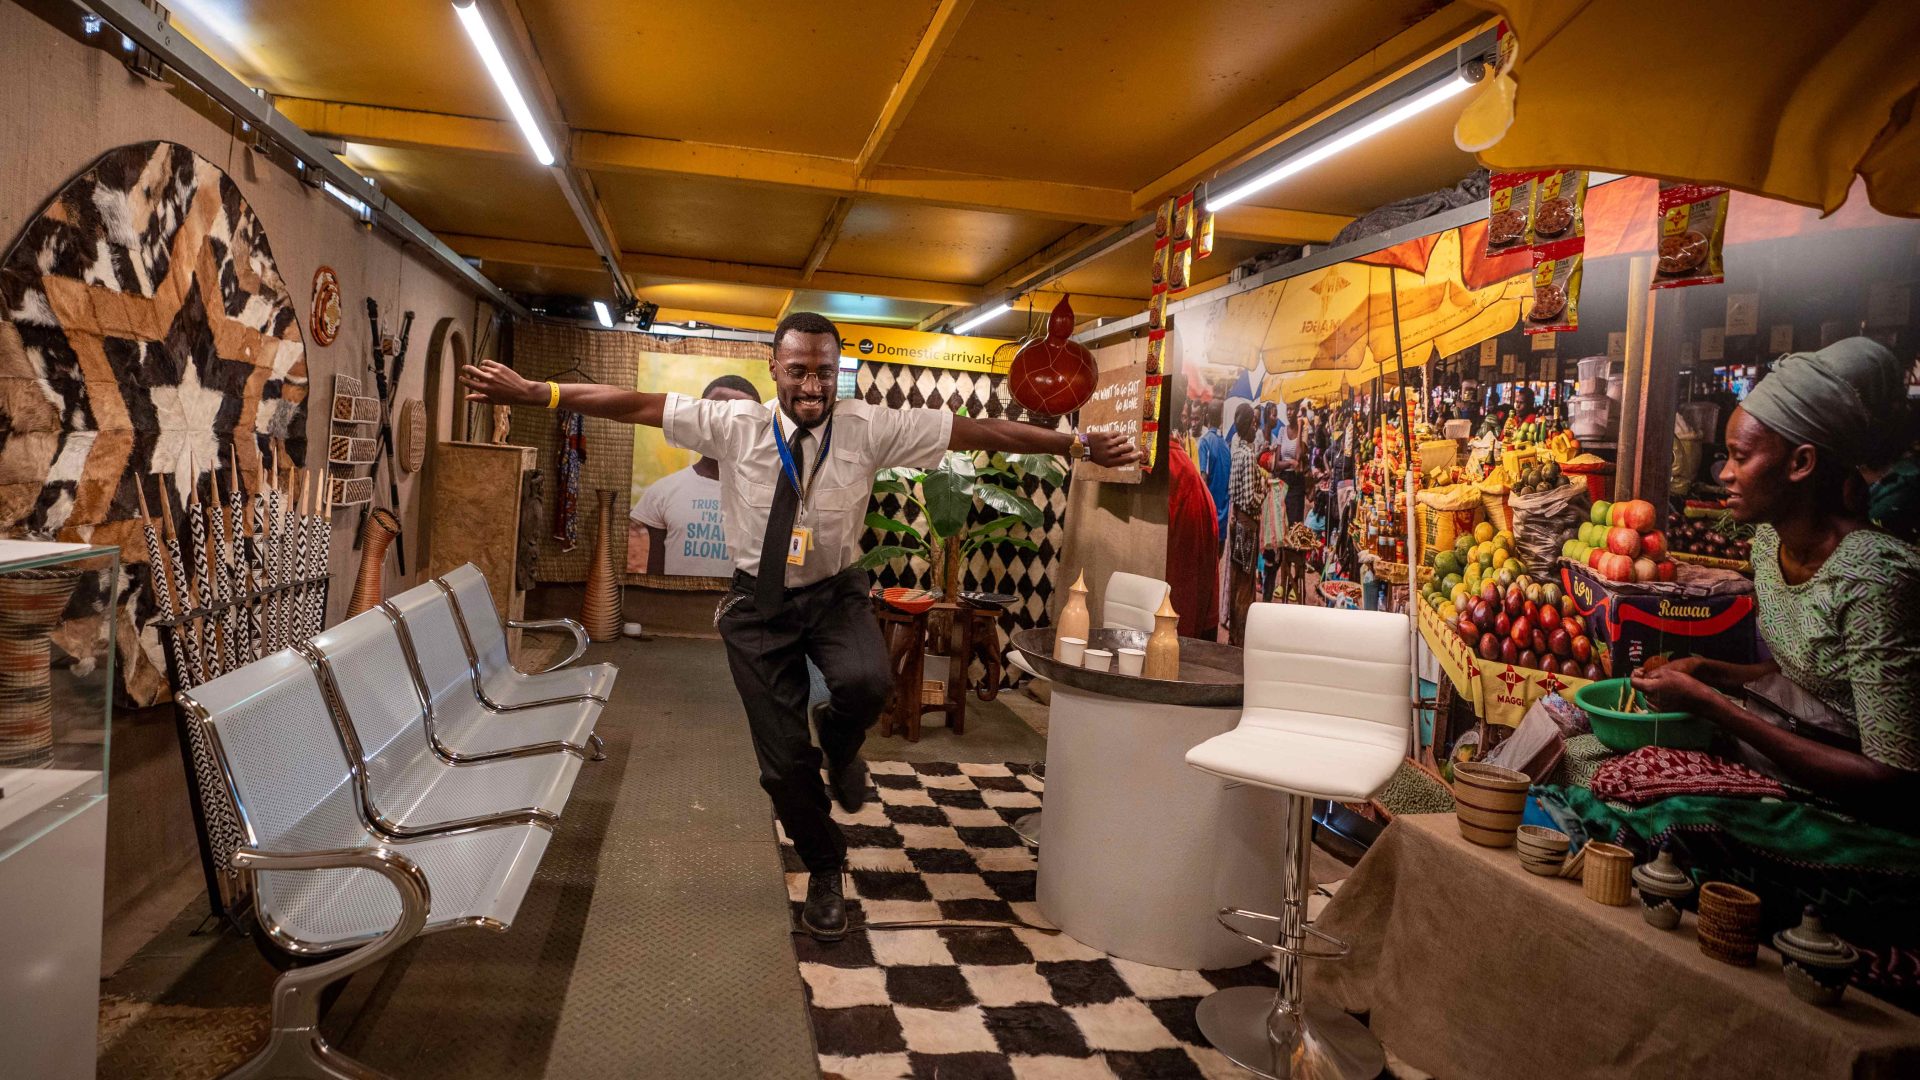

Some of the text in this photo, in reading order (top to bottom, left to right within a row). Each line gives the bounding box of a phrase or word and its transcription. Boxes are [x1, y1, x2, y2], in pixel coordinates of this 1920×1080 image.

[876, 343, 992, 366] Domestic arrivals
[692, 499, 720, 511] TRUS
[687, 522, 725, 542] SMA
[1658, 599, 1711, 618] Rawaa
[1497, 694, 1525, 707] MAGGI
